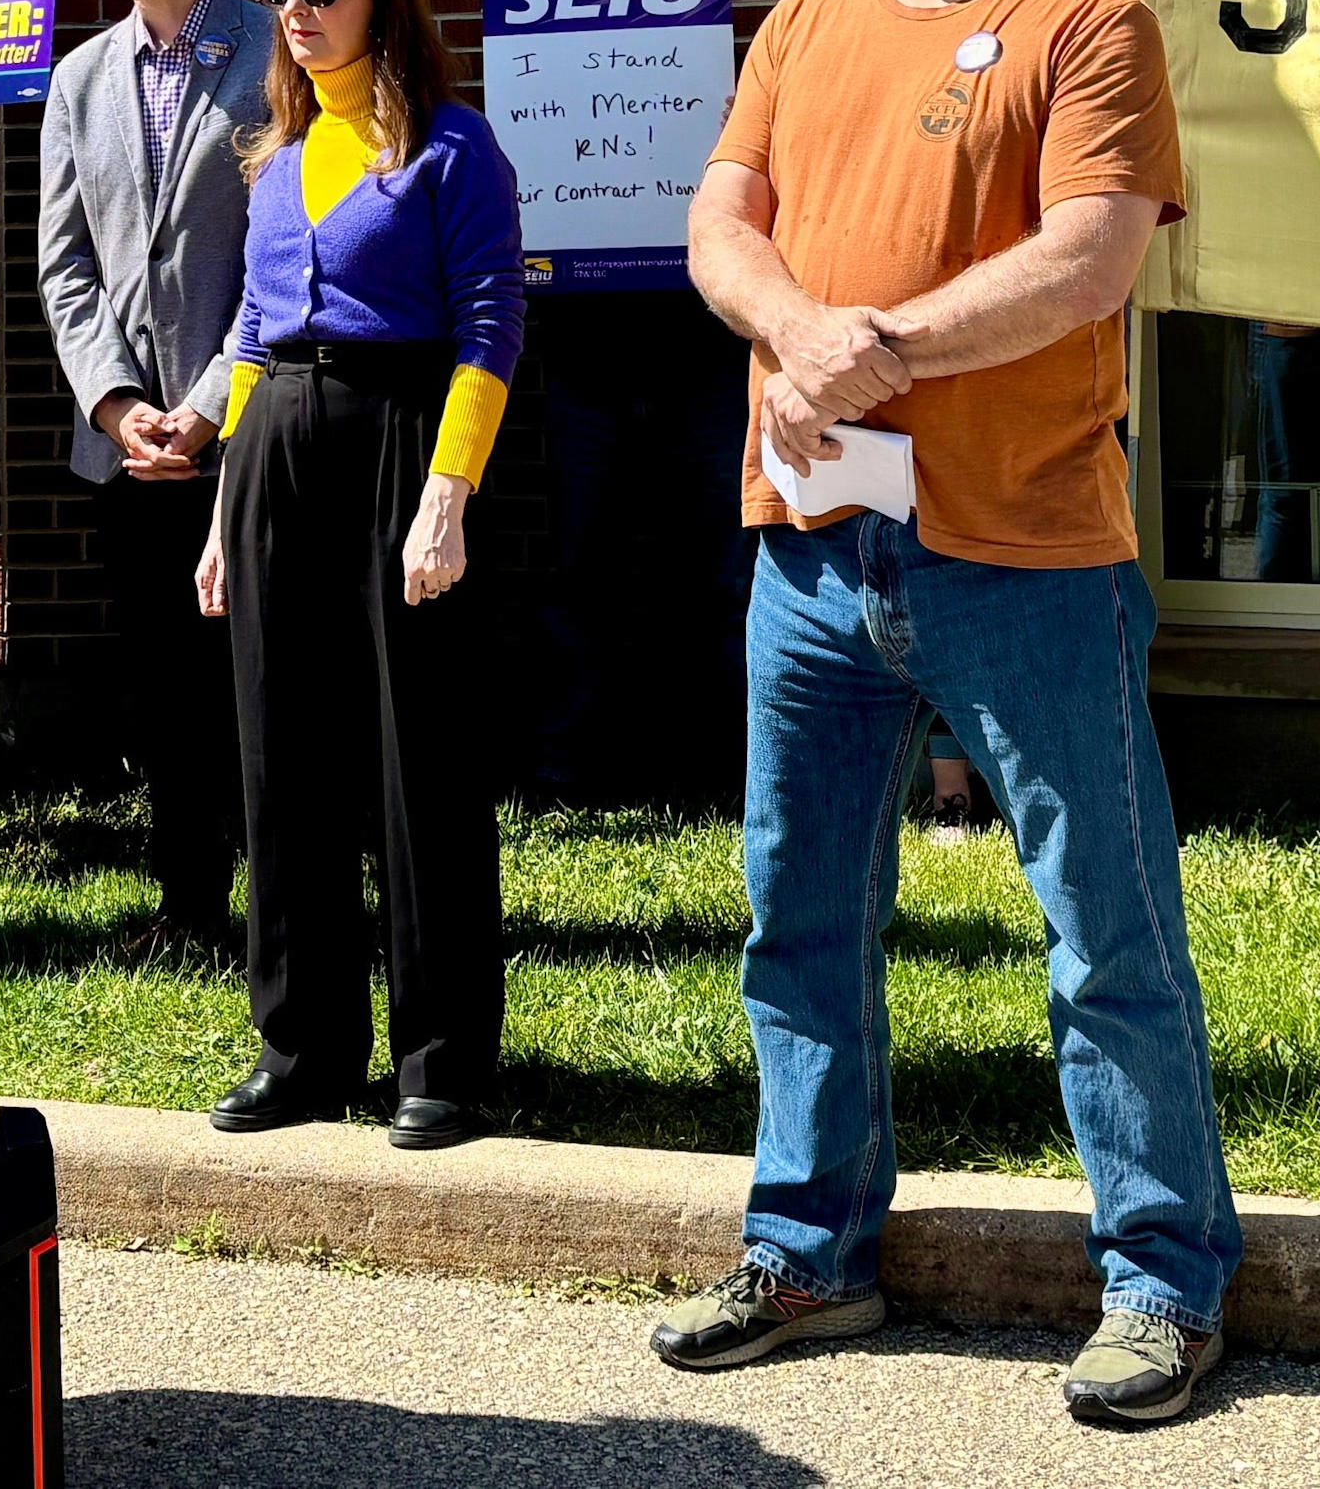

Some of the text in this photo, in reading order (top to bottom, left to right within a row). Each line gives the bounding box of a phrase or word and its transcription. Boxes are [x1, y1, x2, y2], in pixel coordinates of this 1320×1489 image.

[512, 53, 540, 77] I
[511, 93, 703, 123] with Meriter
[927, 104, 960, 115] SCFL
[516, 185, 543, 204] air
[555, 182, 645, 202] Contract
